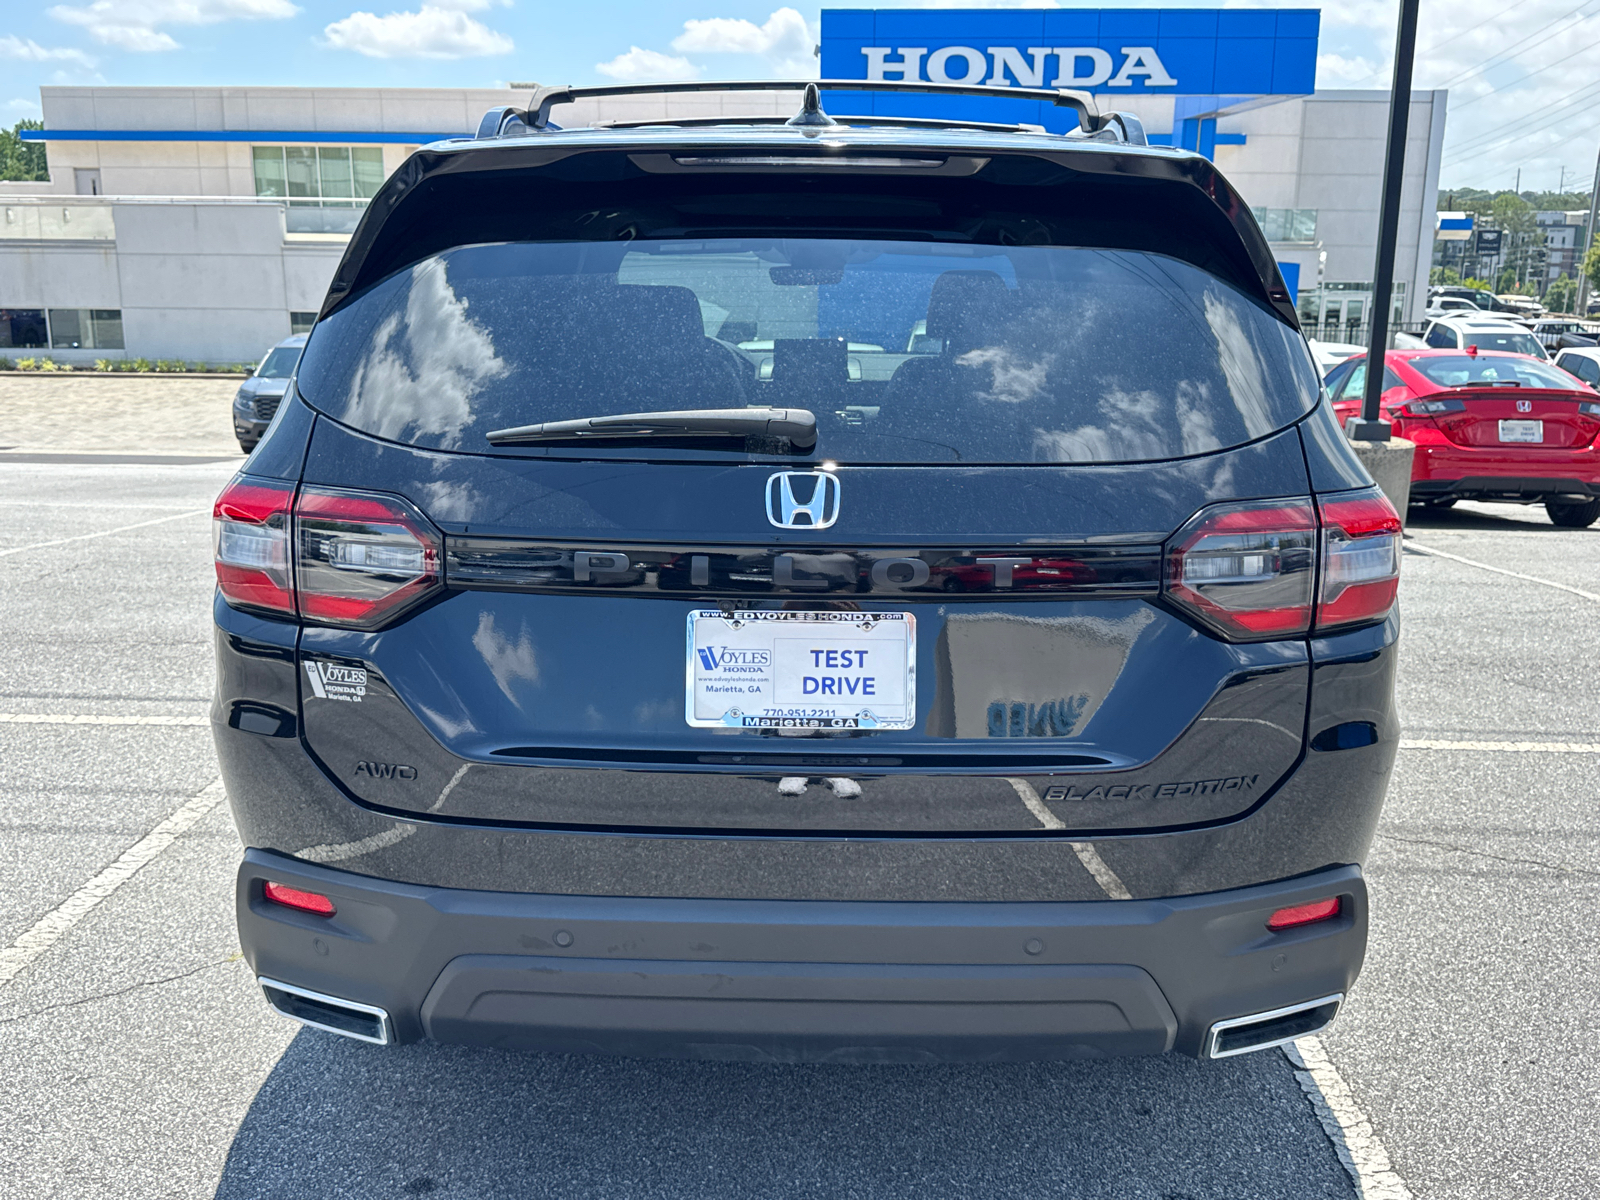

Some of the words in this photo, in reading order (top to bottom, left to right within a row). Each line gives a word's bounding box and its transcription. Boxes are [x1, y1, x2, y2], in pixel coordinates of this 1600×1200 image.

[861, 46, 1178, 87] HONDA
[574, 551, 1032, 587] PILOT
[706, 646, 769, 669] VOYLES
[810, 649, 869, 668] TEST
[316, 661, 365, 684] VOYLES
[325, 685, 357, 693] HONDA
[705, 685, 745, 693] Marietta,
[748, 685, 762, 693] GA
[802, 676, 876, 695] DRIVE
[745, 717, 825, 728] Marietta,
[831, 718, 857, 728] GA
[763, 708, 836, 717] 770-951-2211
[354, 760, 418, 781] AWD
[1042, 784, 1151, 801] BLACK
[1153, 774, 1260, 799] EDITION
